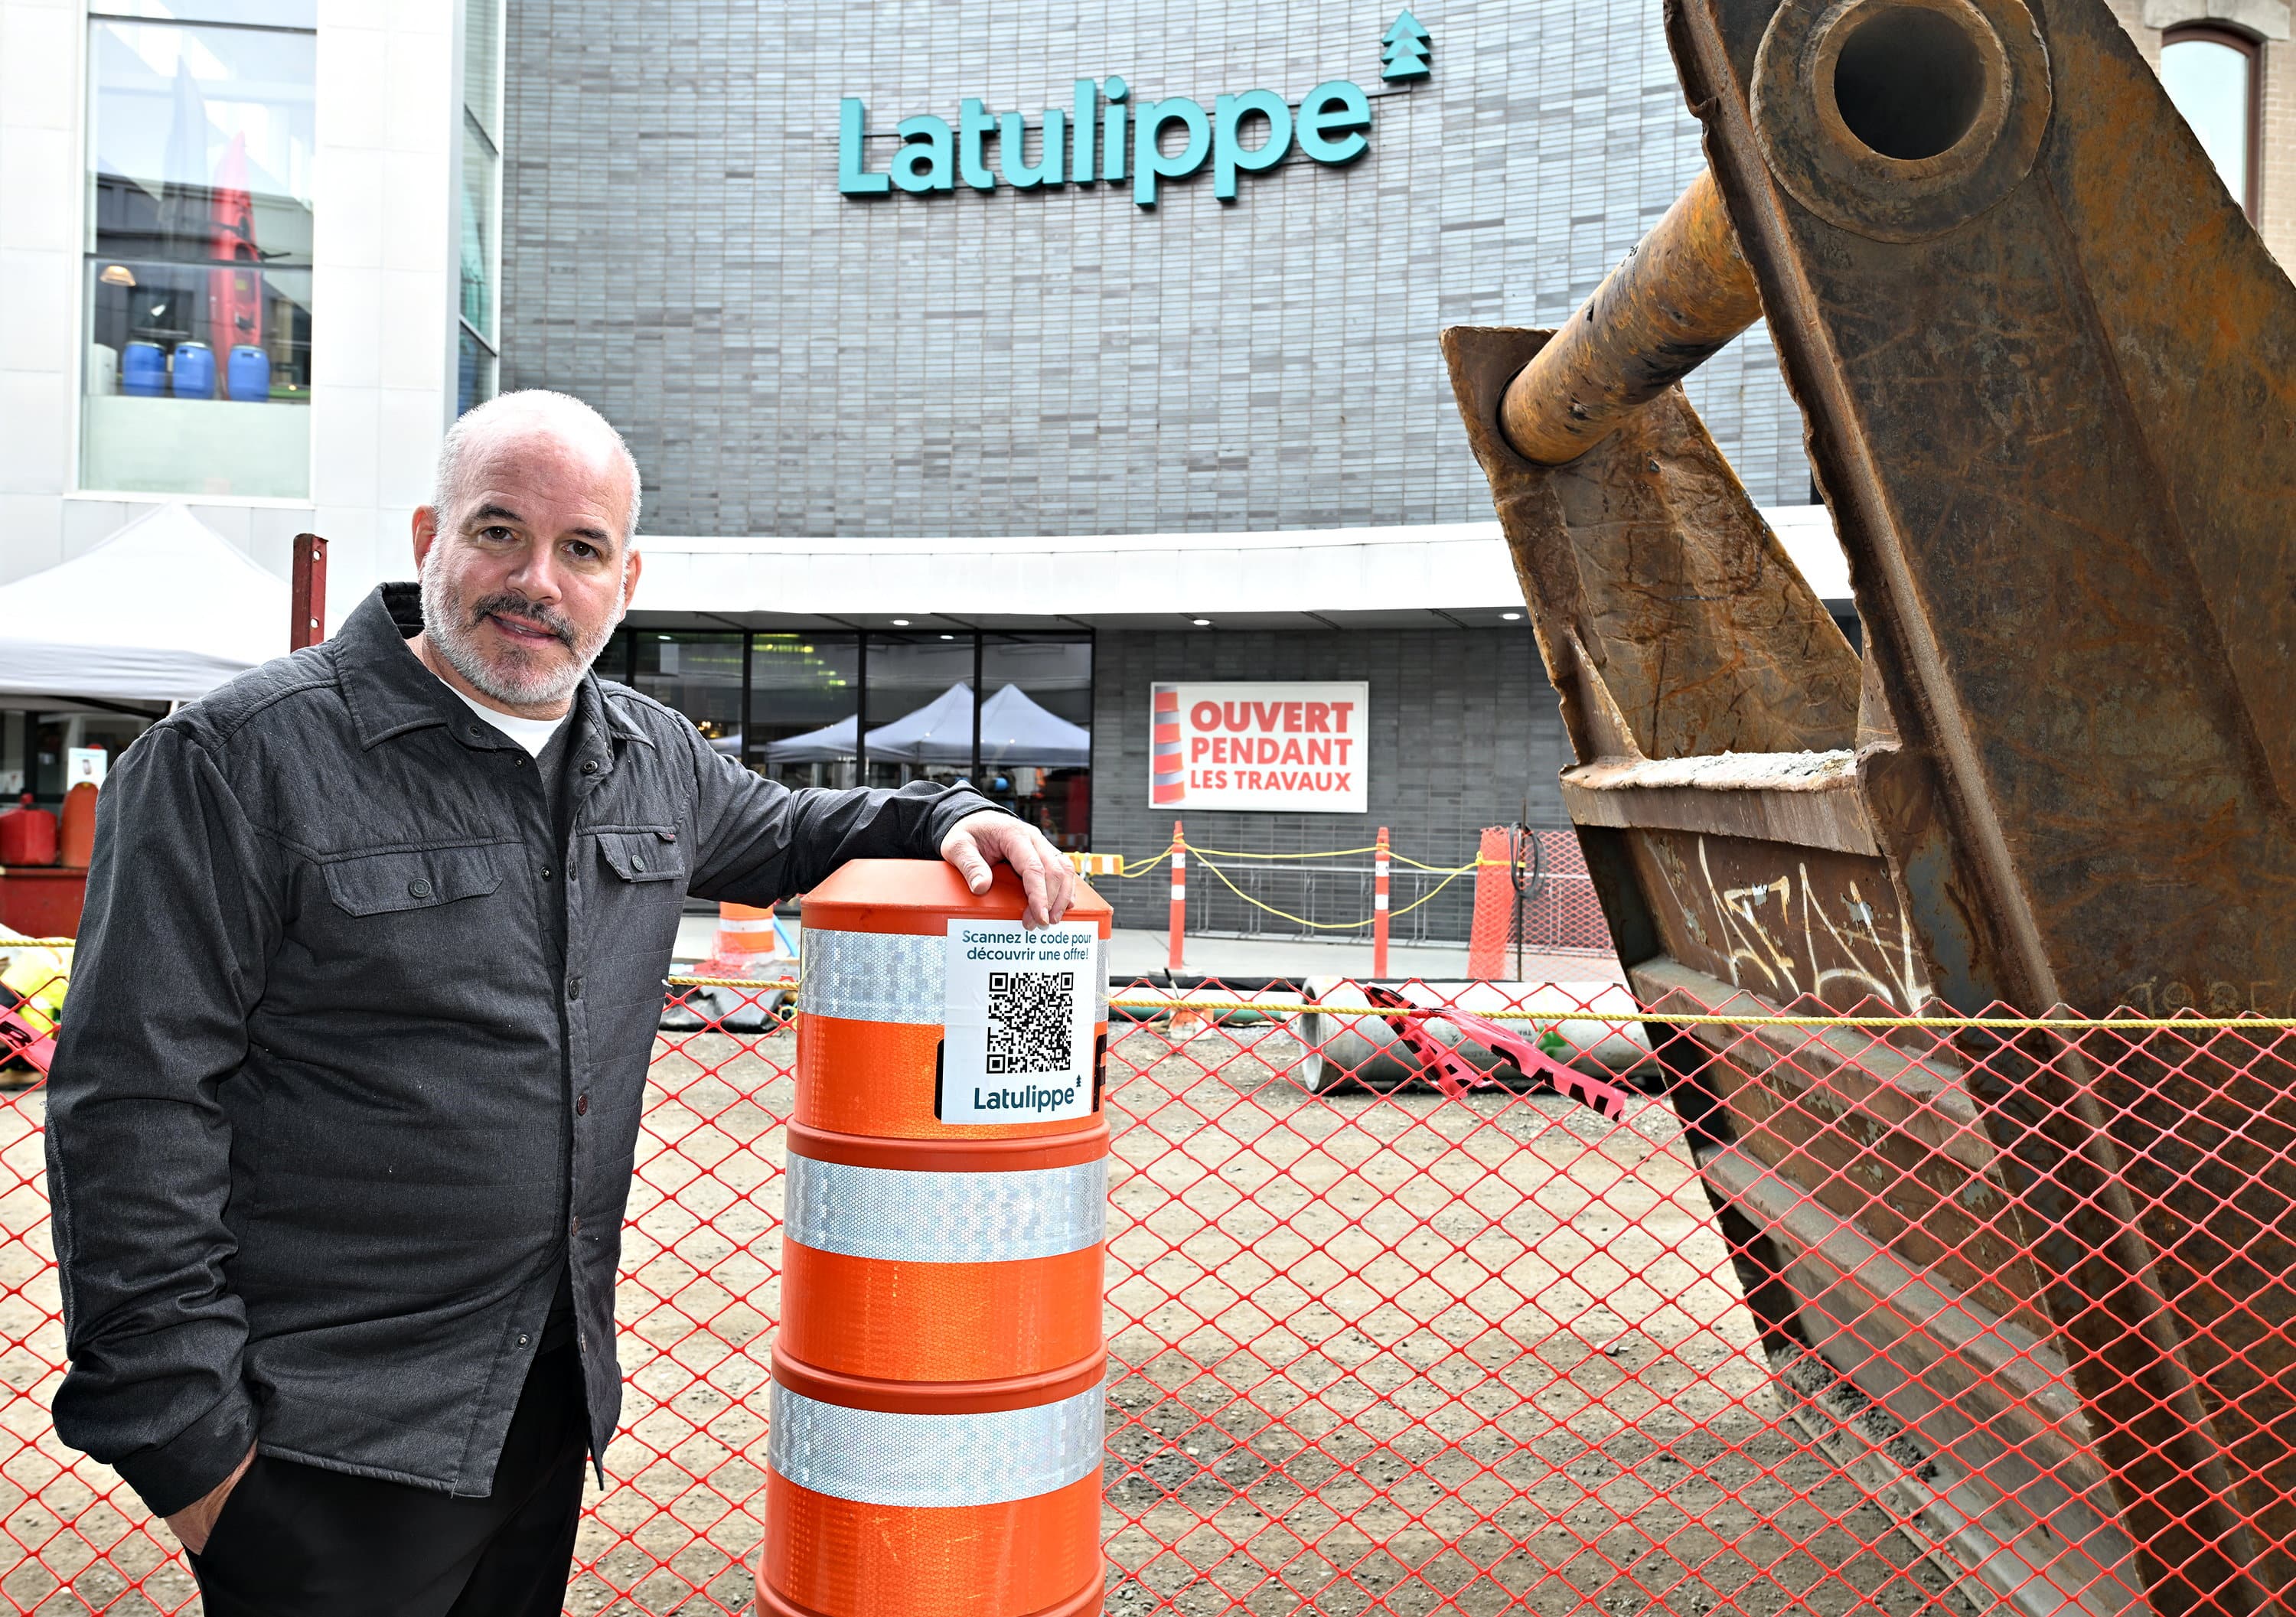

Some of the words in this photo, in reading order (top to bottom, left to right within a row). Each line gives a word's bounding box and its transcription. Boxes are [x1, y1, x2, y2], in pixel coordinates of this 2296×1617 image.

[839, 75, 1372, 210] Latulippe
[1190, 700, 1354, 733] OUVERT
[1191, 737, 1353, 766] PENDANT
[1191, 770, 1228, 789] LES
[1234, 771, 1351, 792] TRAVAUX
[962, 930, 1022, 944] Scannez
[1025, 931, 1037, 944] le
[1040, 931, 1069, 944] code
[1071, 934, 1091, 947] pour
[967, 947, 1035, 960] découvrir
[1039, 951, 1061, 960] une
[1063, 948, 1088, 960] offre!
[974, 1084, 1075, 1113] Latulippe
